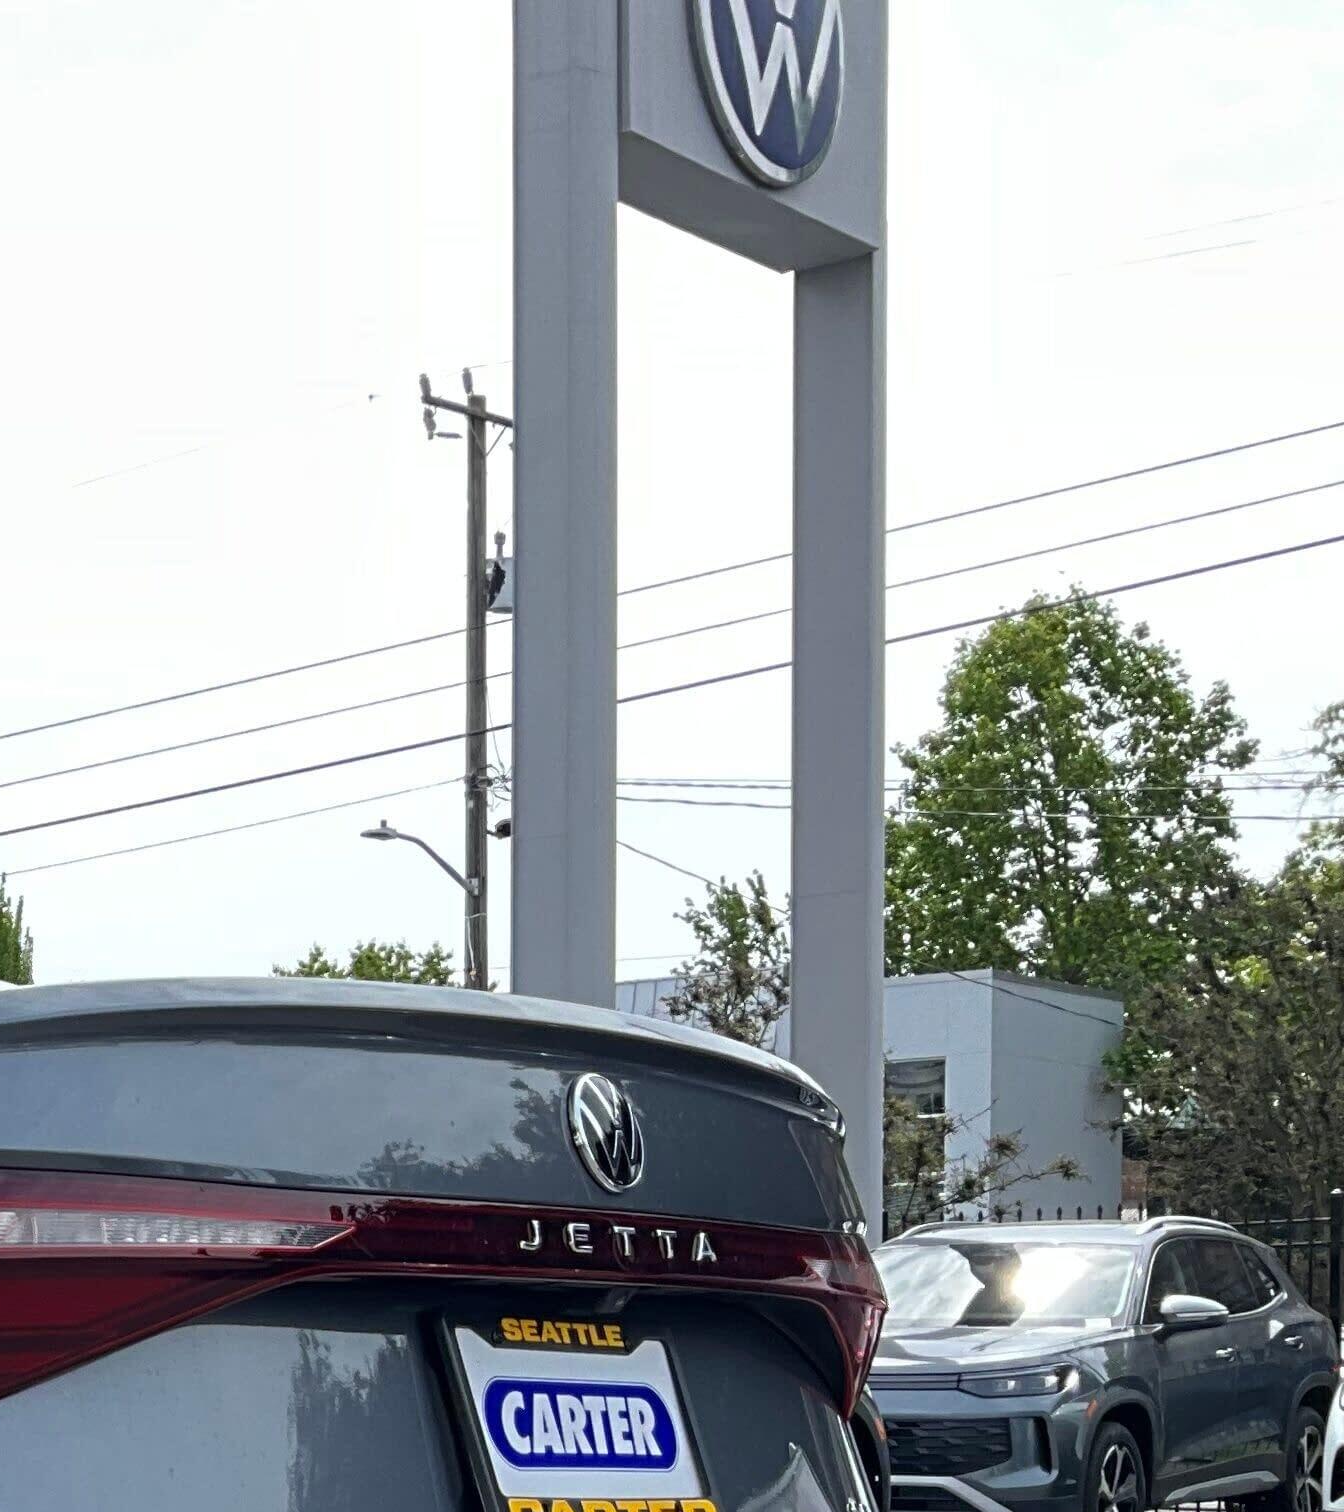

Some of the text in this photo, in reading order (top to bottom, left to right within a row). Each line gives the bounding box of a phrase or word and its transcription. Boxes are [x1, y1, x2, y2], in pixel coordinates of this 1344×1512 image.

[519, 1219, 718, 1263] JETTA
[501, 1317, 625, 1349] SEATTLE
[501, 1390, 663, 1457] CARTER
